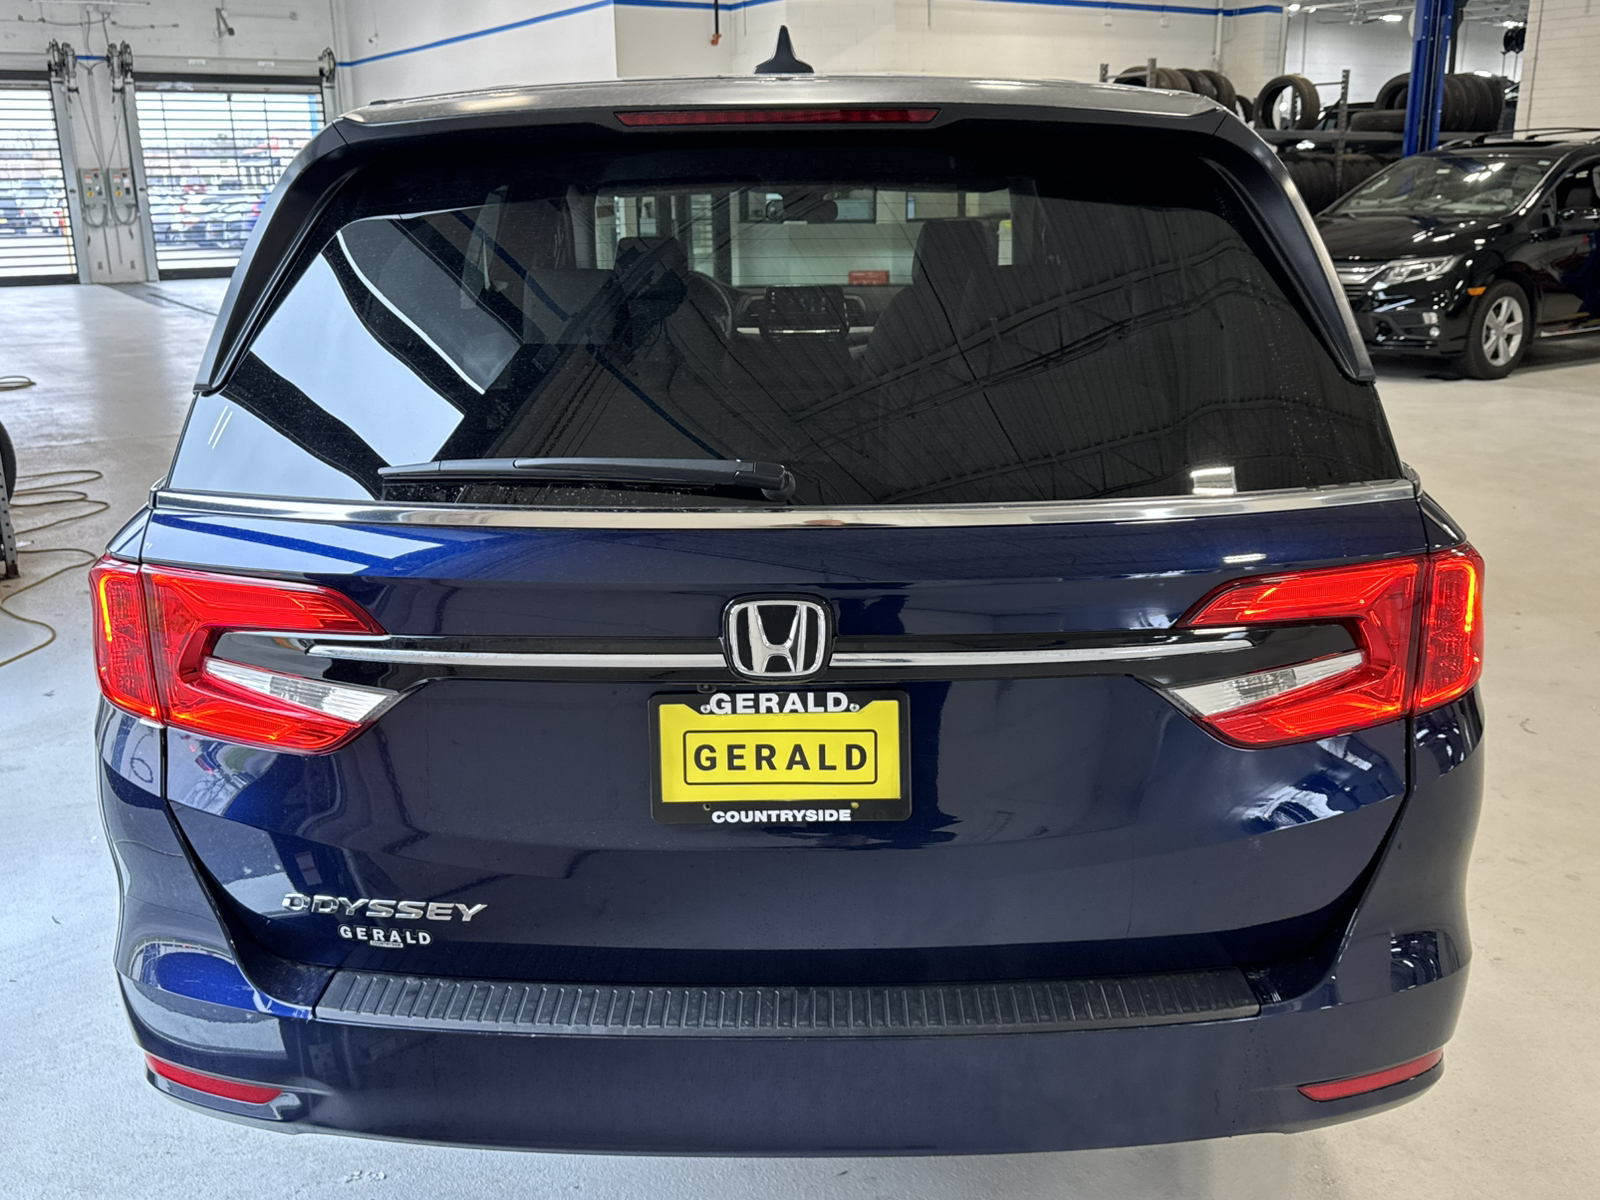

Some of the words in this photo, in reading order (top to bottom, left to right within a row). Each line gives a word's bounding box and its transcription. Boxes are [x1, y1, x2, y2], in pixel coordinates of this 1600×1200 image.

[709, 692, 847, 715] GERALD
[694, 744, 867, 770] GERALD
[712, 809, 851, 823] COUNTRYSIDE
[281, 893, 487, 922] ODYSSEY
[339, 925, 431, 945] GERALD
